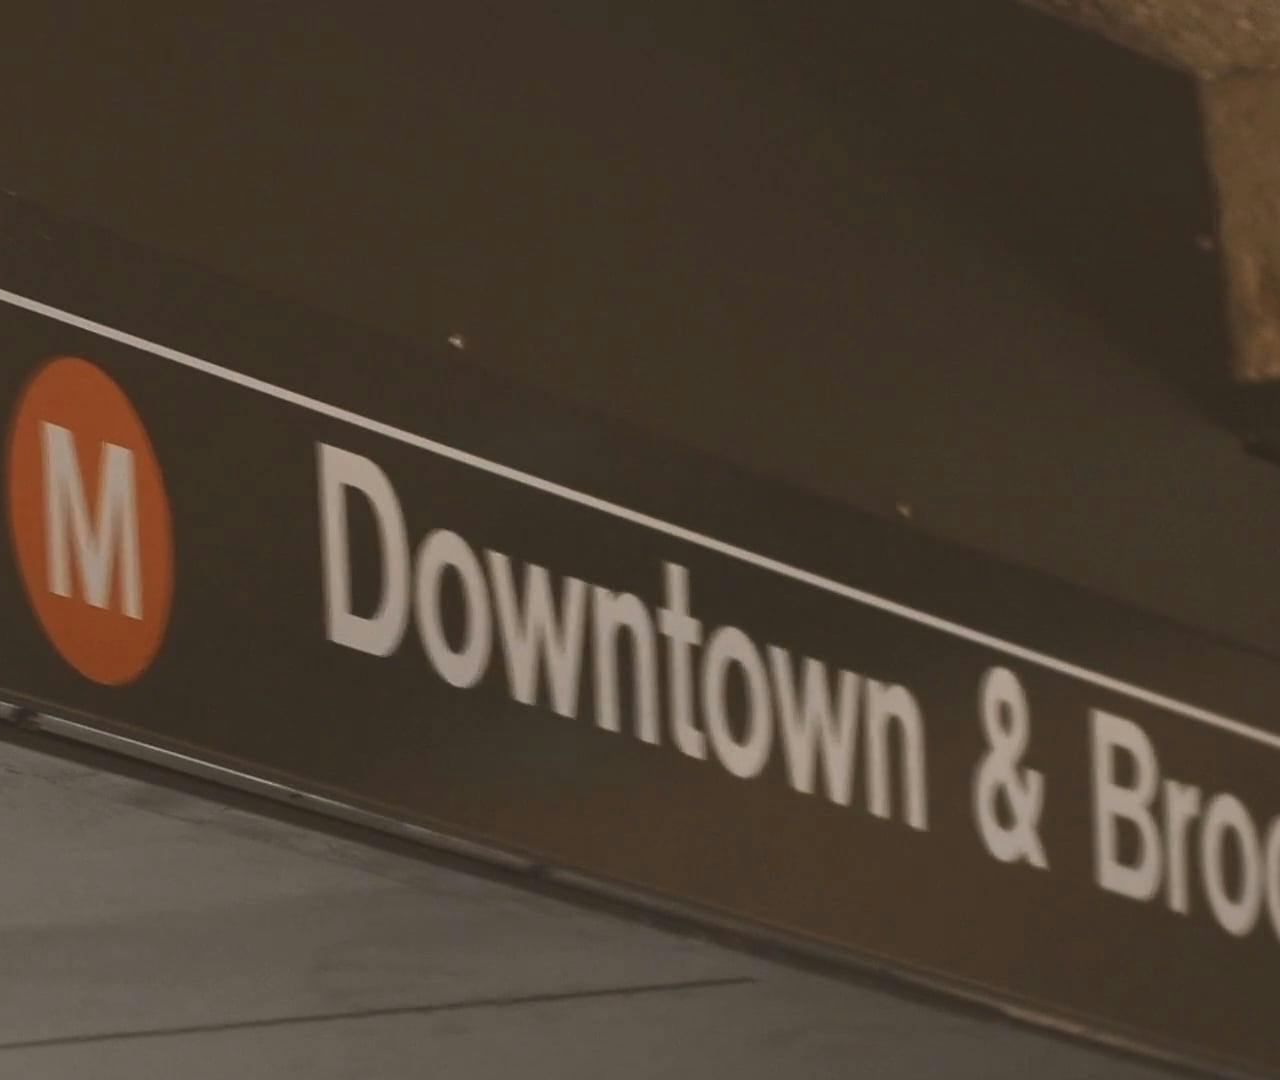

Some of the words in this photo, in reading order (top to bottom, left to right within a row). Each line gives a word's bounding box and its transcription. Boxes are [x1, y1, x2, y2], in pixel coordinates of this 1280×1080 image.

[40, 419, 141, 619] M
[318, 442, 927, 831] Downtown
[973, 665, 1048, 869] &
